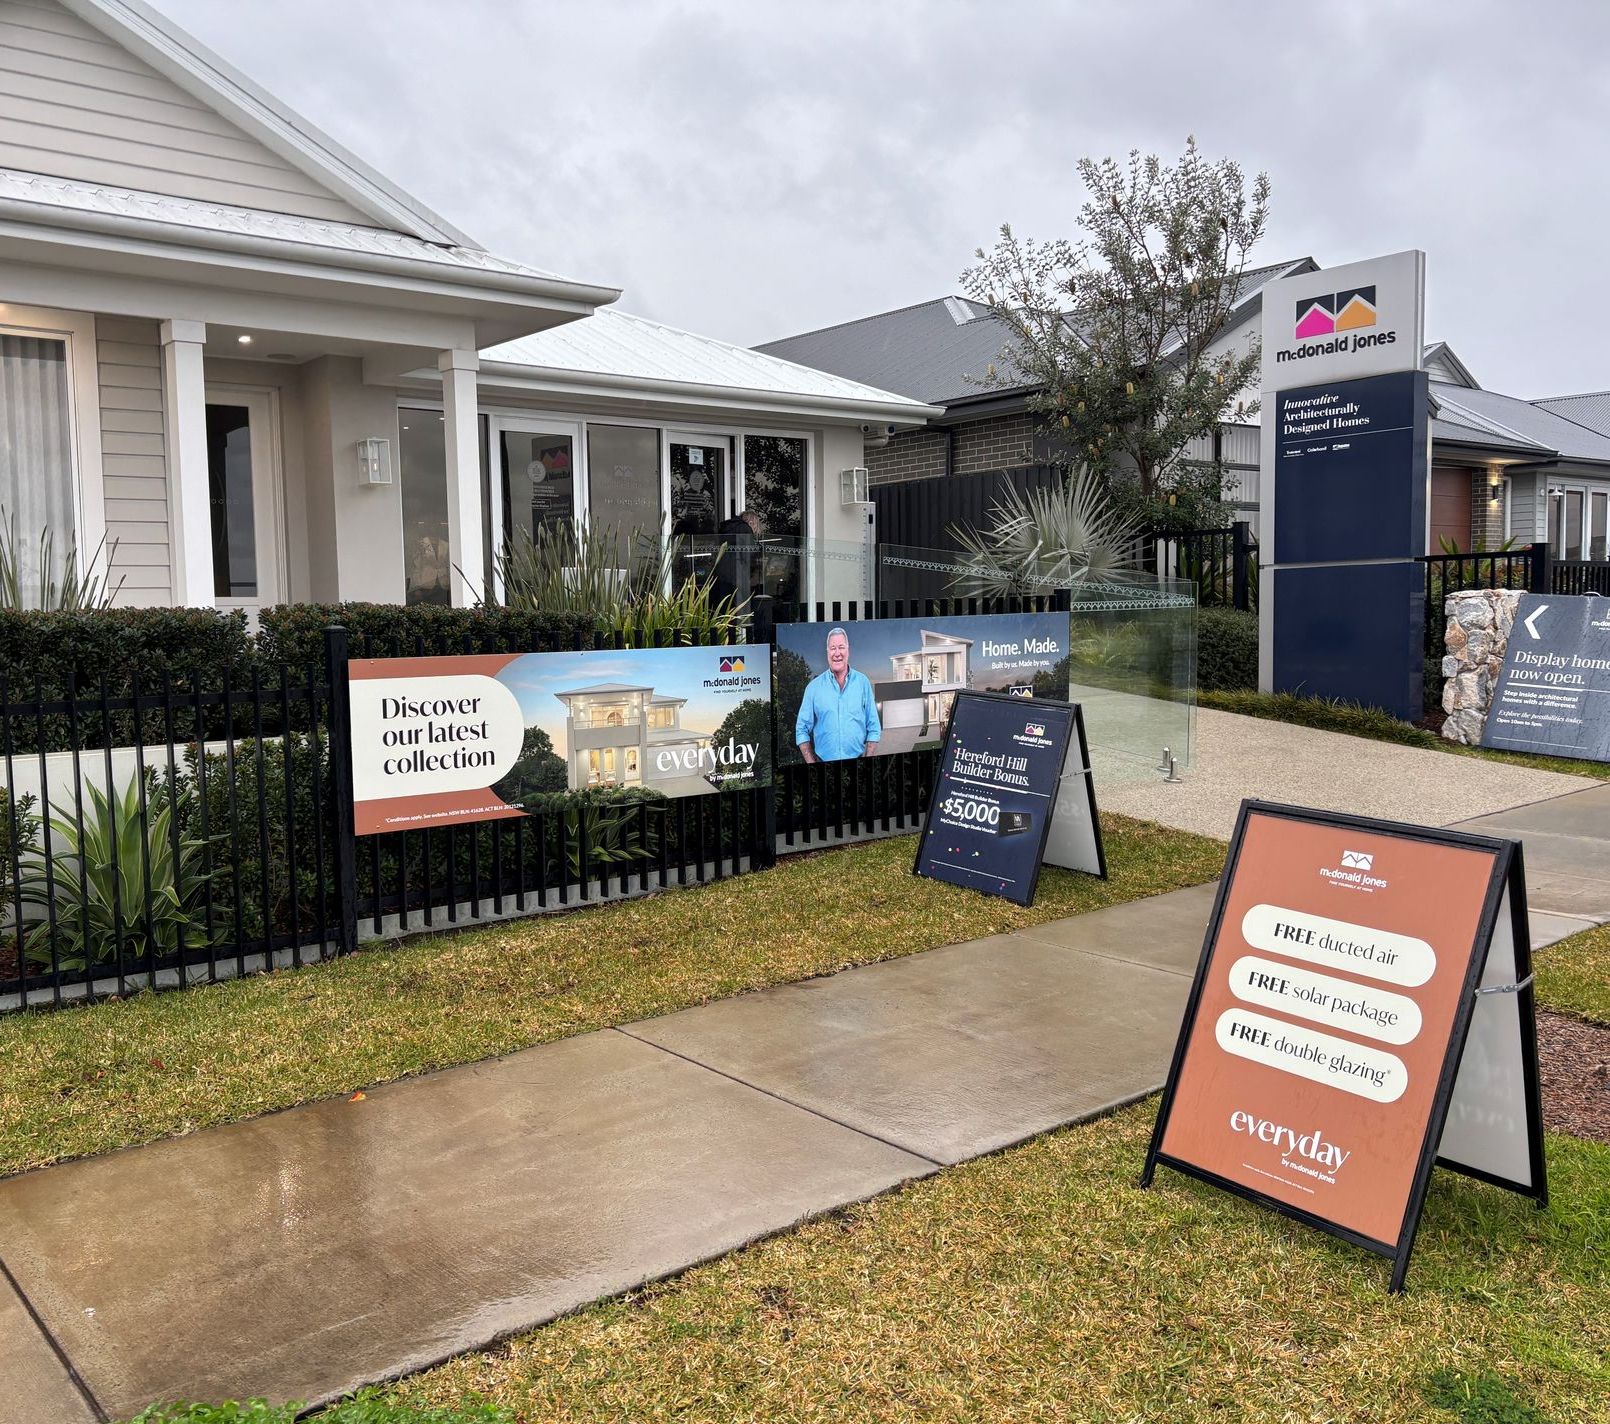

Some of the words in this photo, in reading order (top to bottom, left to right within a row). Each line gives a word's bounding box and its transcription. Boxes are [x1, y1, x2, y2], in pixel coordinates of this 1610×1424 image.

[1277, 336, 1348, 362] mcdonald
[1351, 331, 1396, 353] jones
[1284, 394, 1339, 409] Innovative
[1284, 403, 1360, 421] Architecturally
[1284, 420, 1329, 435] Designed
[1333, 417, 1369, 428] Homes
[982, 640, 1021, 656] Home.
[1024, 637, 1059, 654] Made.
[1514, 651, 1569, 670] Display
[704, 677, 739, 687] mcdonald
[741, 676, 760, 687] jones
[1509, 669, 1542, 680] now
[1544, 672, 1585, 685] open.
[382, 696, 480, 719] Discover
[1498, 710, 1520, 718] Explore
[1544, 700, 1576, 709] difference.
[383, 729, 423, 747] our
[428, 721, 488, 743] latest
[1038, 737, 1053, 746] jones
[384, 747, 495, 775] collection
[657, 737, 759, 773] everyday
[955, 748, 1005, 768] Hereford
[1006, 756, 1028, 771] Hill
[741, 771, 754, 779] jones
[952, 761, 992, 779] Builder
[994, 768, 1029, 786] Bonus.
[944, 798, 1000, 825] $5,000
[1320, 868, 1361, 882] mcdonald
[1361, 874, 1387, 888] jones
[1274, 922, 1317, 946] FREE
[1319, 934, 1375, 960] ducted
[1377, 948, 1398, 966] air
[1248, 971, 1291, 995] FREE
[1292, 986, 1329, 1006] solar
[1331, 997, 1398, 1028] package
[1230, 1022, 1272, 1048] FREE
[1274, 1036, 1327, 1065] double
[1230, 1111, 1351, 1174] everyday
[1282, 1158, 1289, 1167] by
[1318, 1172, 1335, 1185] jones
